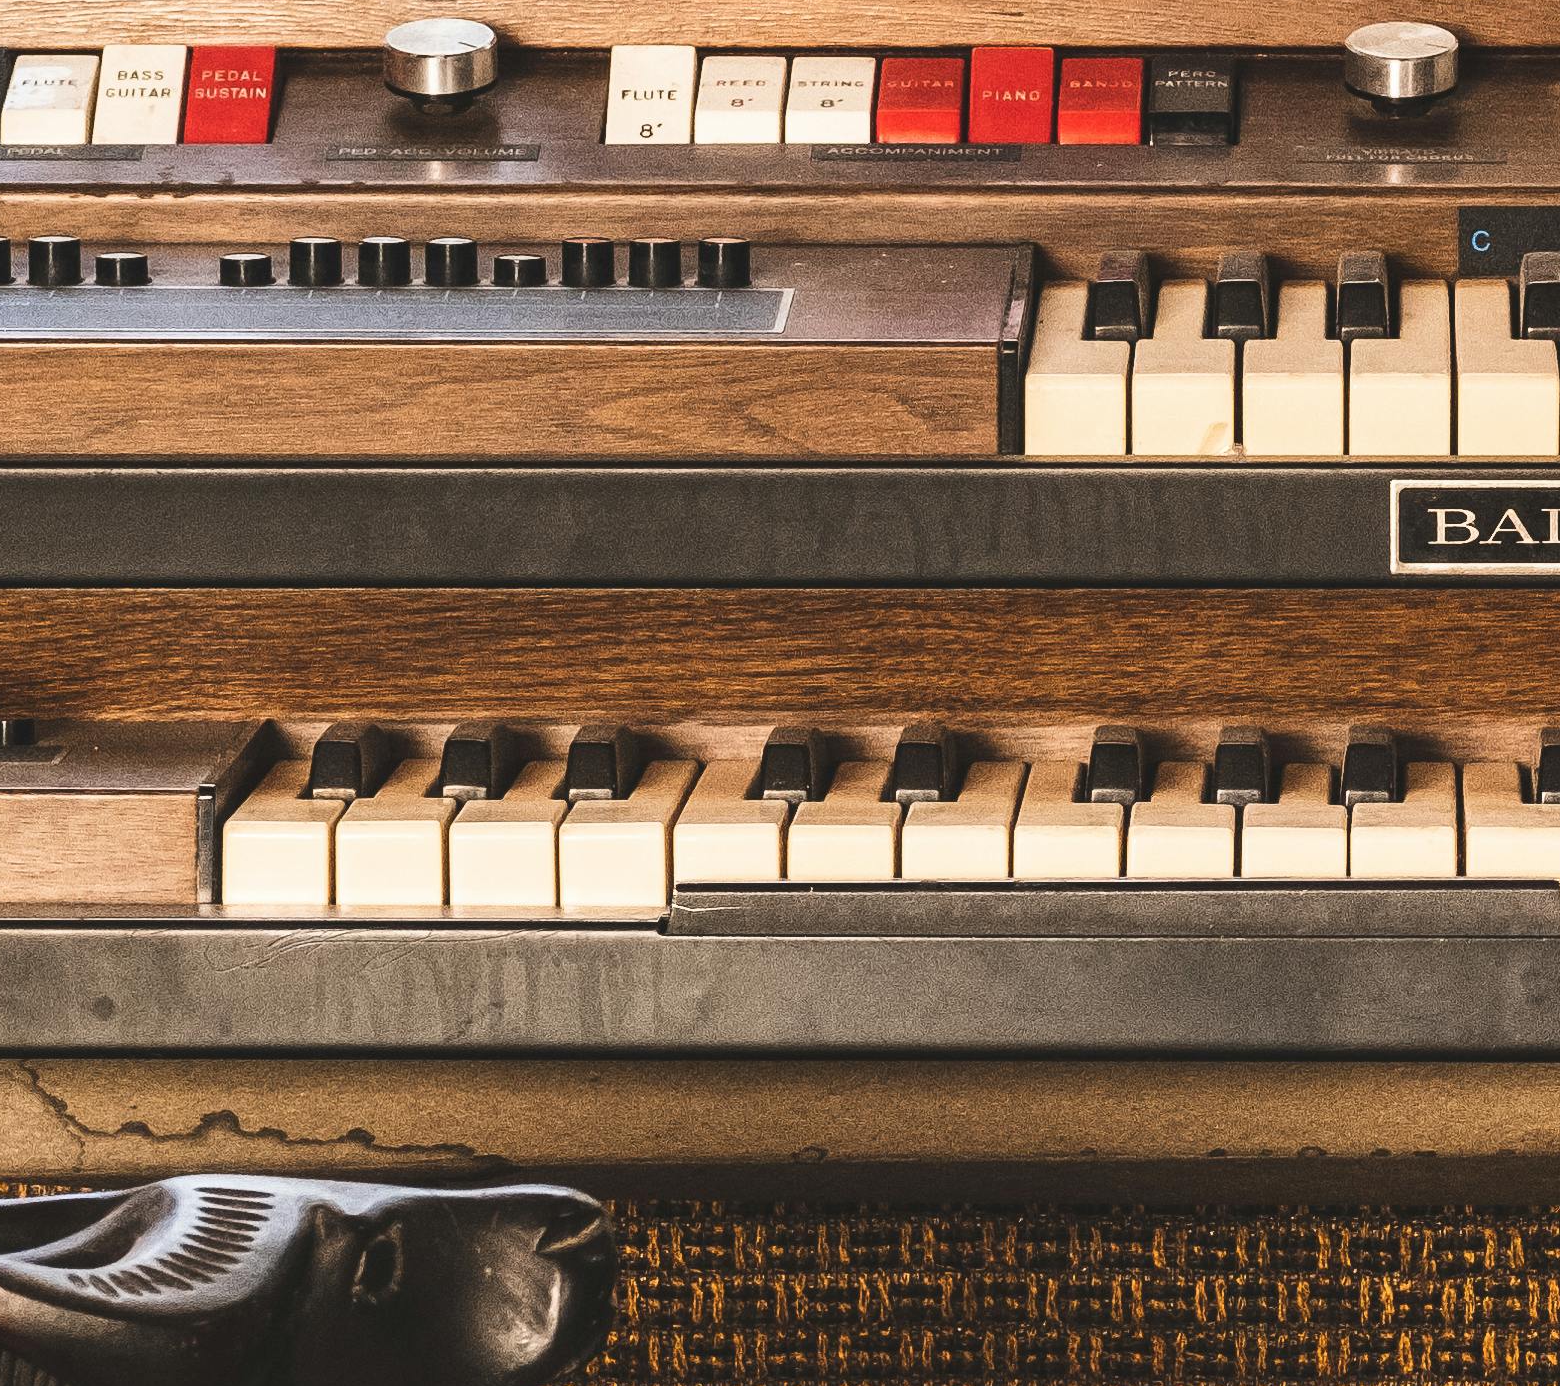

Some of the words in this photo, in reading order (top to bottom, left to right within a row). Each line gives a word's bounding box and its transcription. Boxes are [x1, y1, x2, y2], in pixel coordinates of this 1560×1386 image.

[117, 70, 164, 81] BASS
[201, 70, 263, 82] PEDAL
[21, 78, 78, 87] FLUTE
[797, 80, 865, 88] STRING
[1154, 80, 1229, 88] PATTERN
[105, 87, 171, 98] GUITAR
[194, 87, 268, 99] SUSTAIN
[621, 89, 678, 101] FLUTE
[981, 90, 1041, 102] PIANO
[639, 123, 663, 138] 8'
[1471, 229, 1491, 252] C
